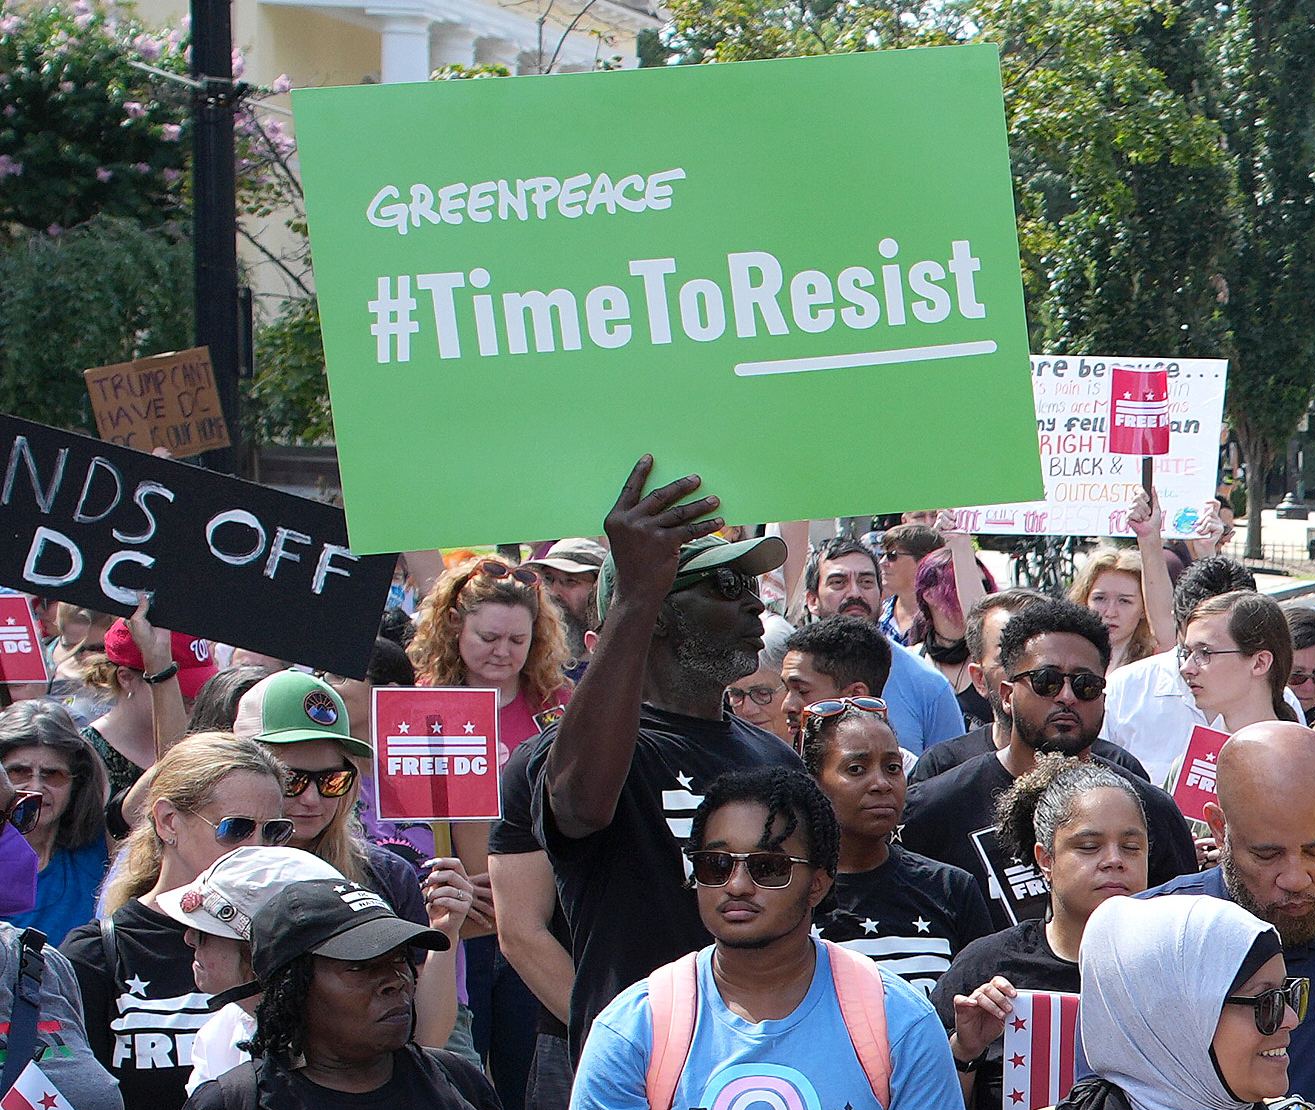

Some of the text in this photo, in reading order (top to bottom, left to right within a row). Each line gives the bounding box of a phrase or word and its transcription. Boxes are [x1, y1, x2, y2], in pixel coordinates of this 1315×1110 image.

[367, 168, 686, 235] GREENPEACE
[368, 238, 985, 364] #TimeToResist
[93, 369, 167, 401] TRUMP
[99, 386, 209, 430] HAVE DC
[1115, 414, 1157, 428] FREE
[1050, 457, 1122, 477] BLACK &
[1024, 511, 1047, 533] the
[23, 526, 156, 606] DC
[206, 509, 361, 595] OFF
[4, 641, 32, 653] DC
[387, 757, 488, 775] FREE DC
